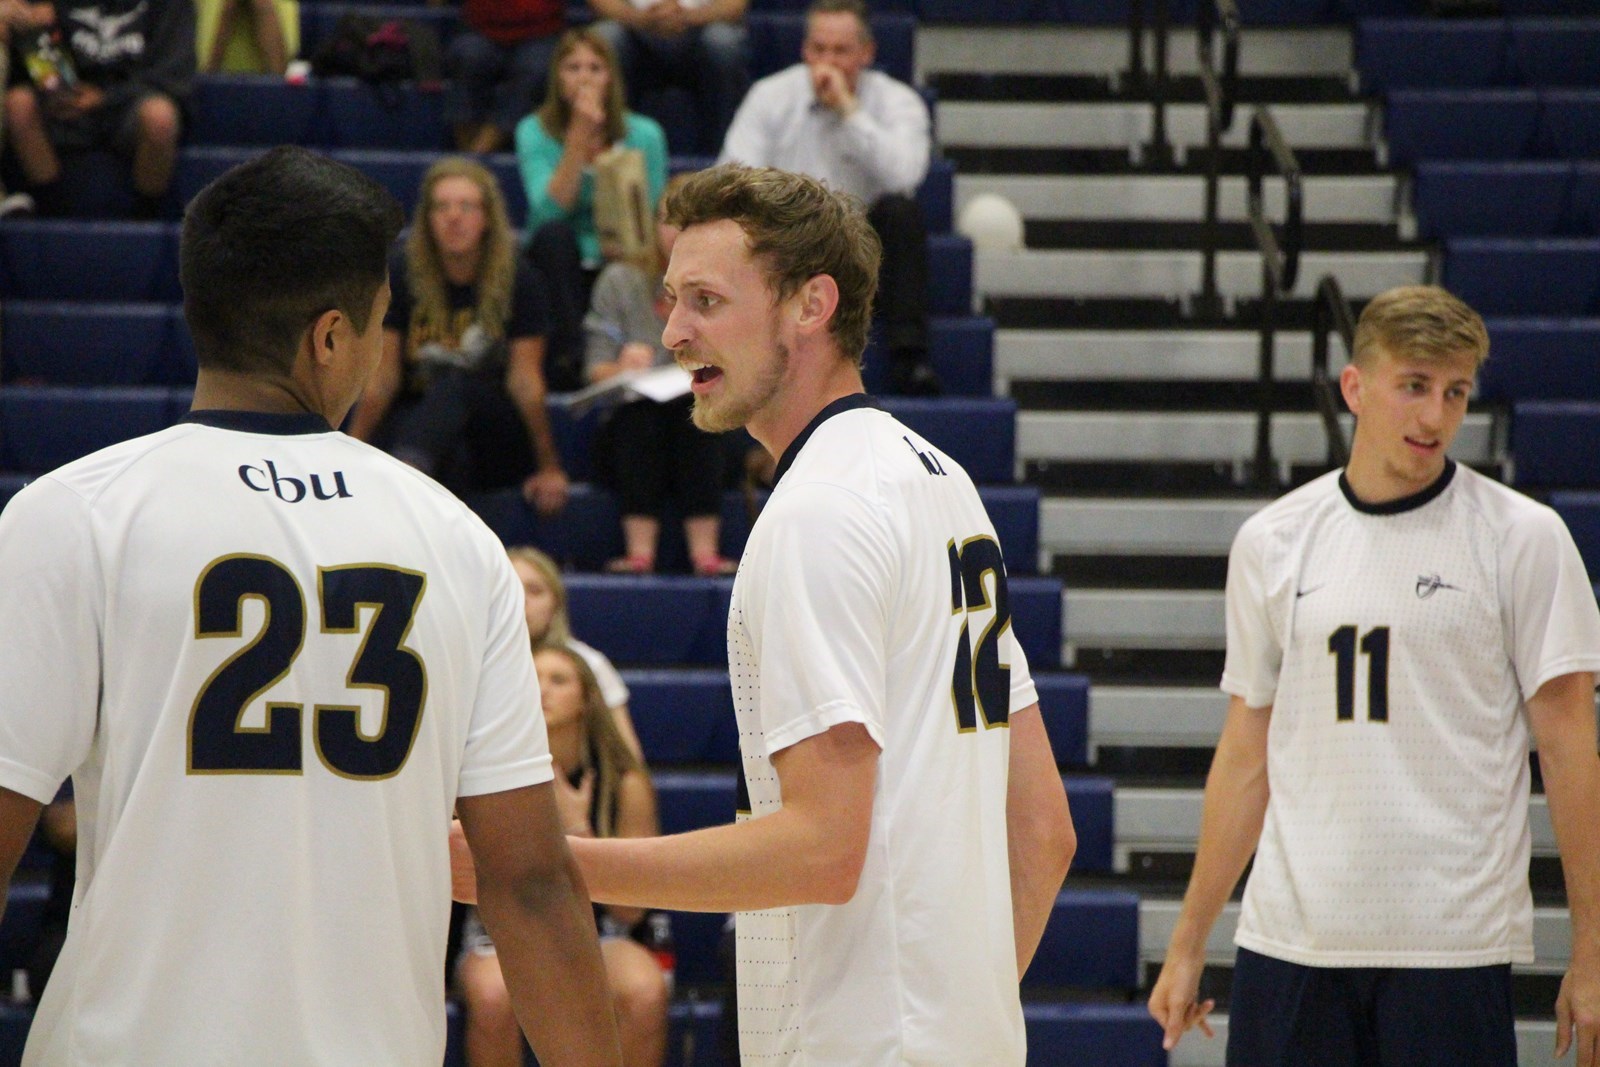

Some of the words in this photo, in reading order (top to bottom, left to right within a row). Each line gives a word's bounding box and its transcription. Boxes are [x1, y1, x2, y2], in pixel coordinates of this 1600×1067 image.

[238, 459, 353, 503] cbu
[186, 552, 428, 781] 23
[947, 534, 1011, 734] 12
[1328, 625, 1390, 723] 11
